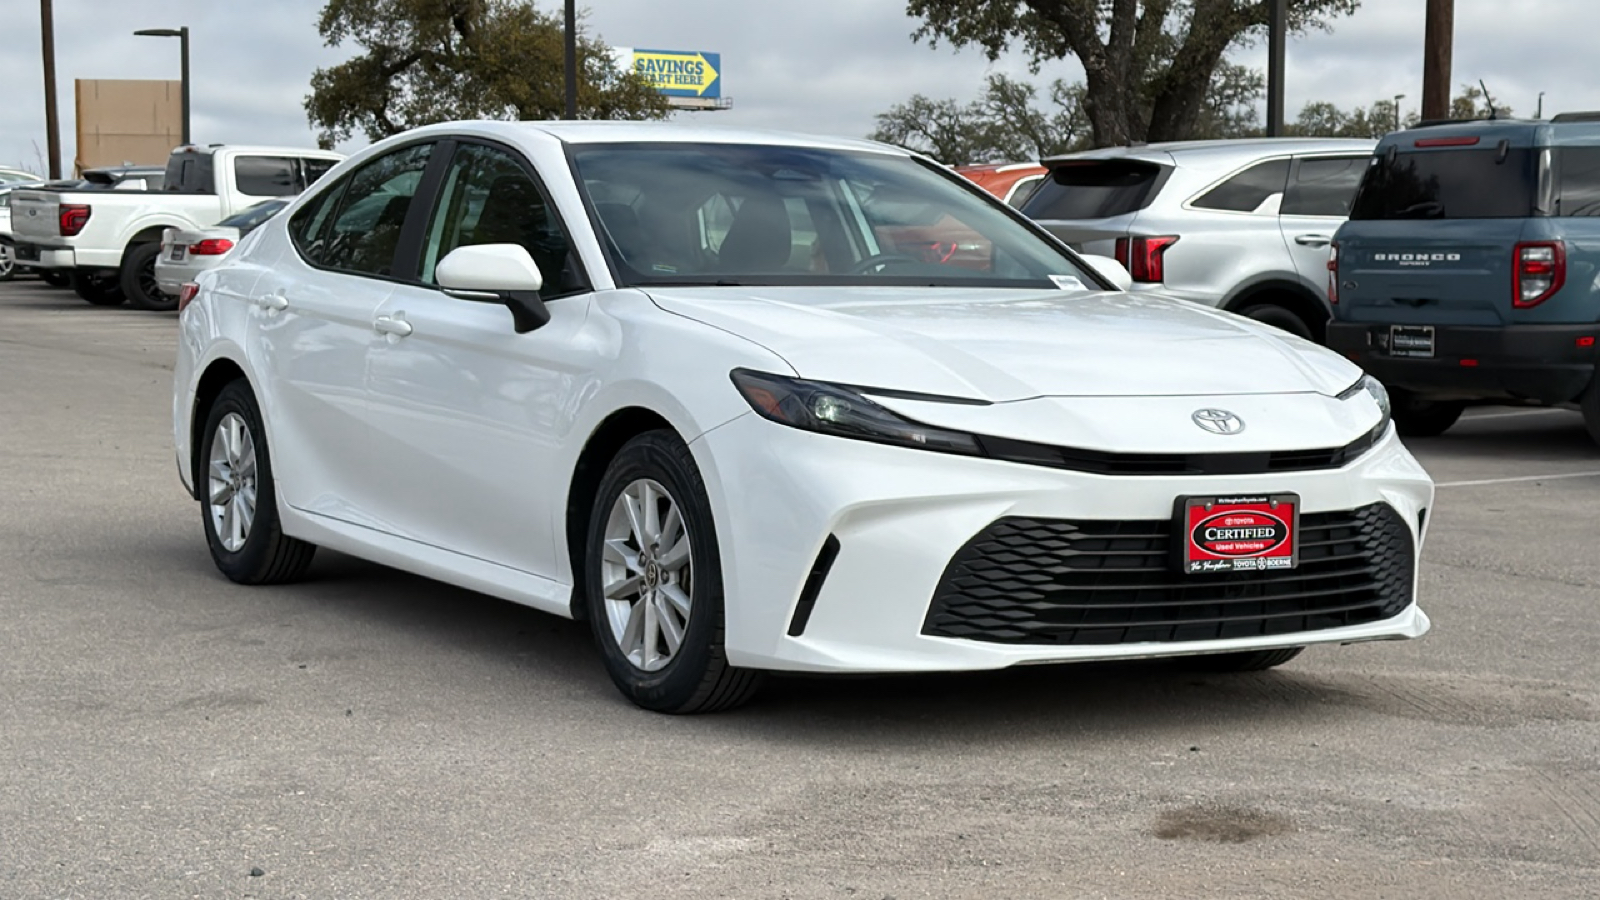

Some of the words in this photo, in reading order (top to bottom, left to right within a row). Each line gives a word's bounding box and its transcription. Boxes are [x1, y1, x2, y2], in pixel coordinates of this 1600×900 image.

[635, 58, 704, 75] SAVINGS
[640, 72, 672, 85] TART
[674, 73, 704, 86] HERE
[1374, 253, 1461, 261] BRONCO
[1215, 543, 1234, 551] Used
[1235, 542, 1265, 550] Vehicles
[1233, 560, 1257, 569] TOYOTA
